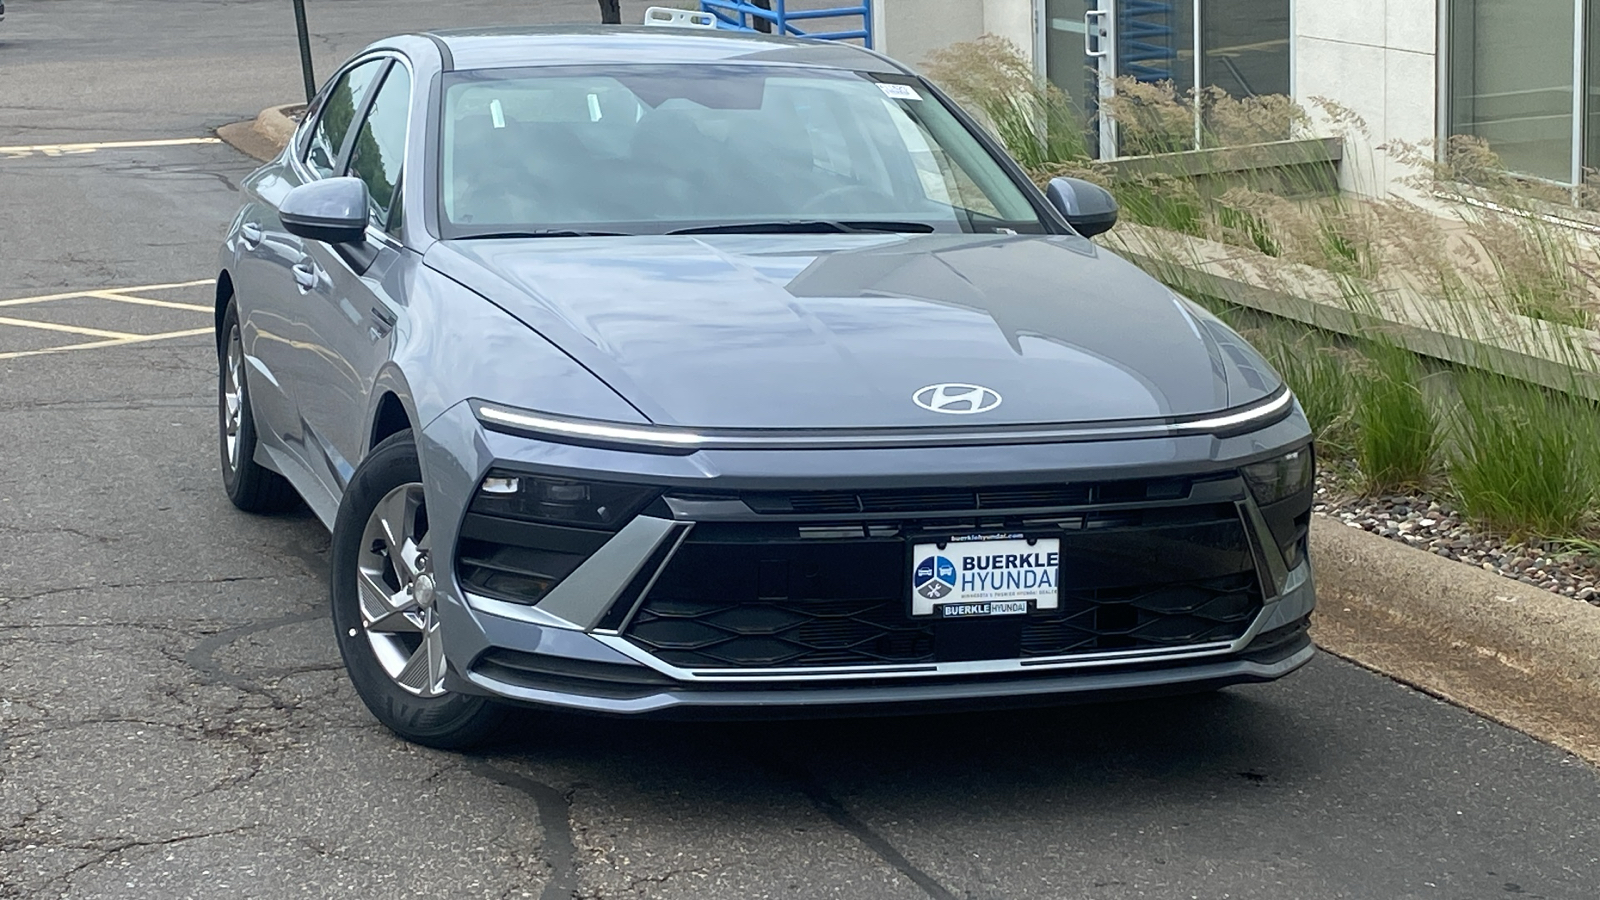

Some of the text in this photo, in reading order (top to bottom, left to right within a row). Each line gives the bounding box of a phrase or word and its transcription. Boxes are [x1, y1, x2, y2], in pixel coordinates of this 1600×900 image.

[951, 533, 1024, 541] buerklehyundai.com
[962, 552, 1058, 571] BUERKLE
[961, 568, 1058, 592] HYUNDAI
[945, 603, 1026, 615] BUERKLE HYUNDAI
